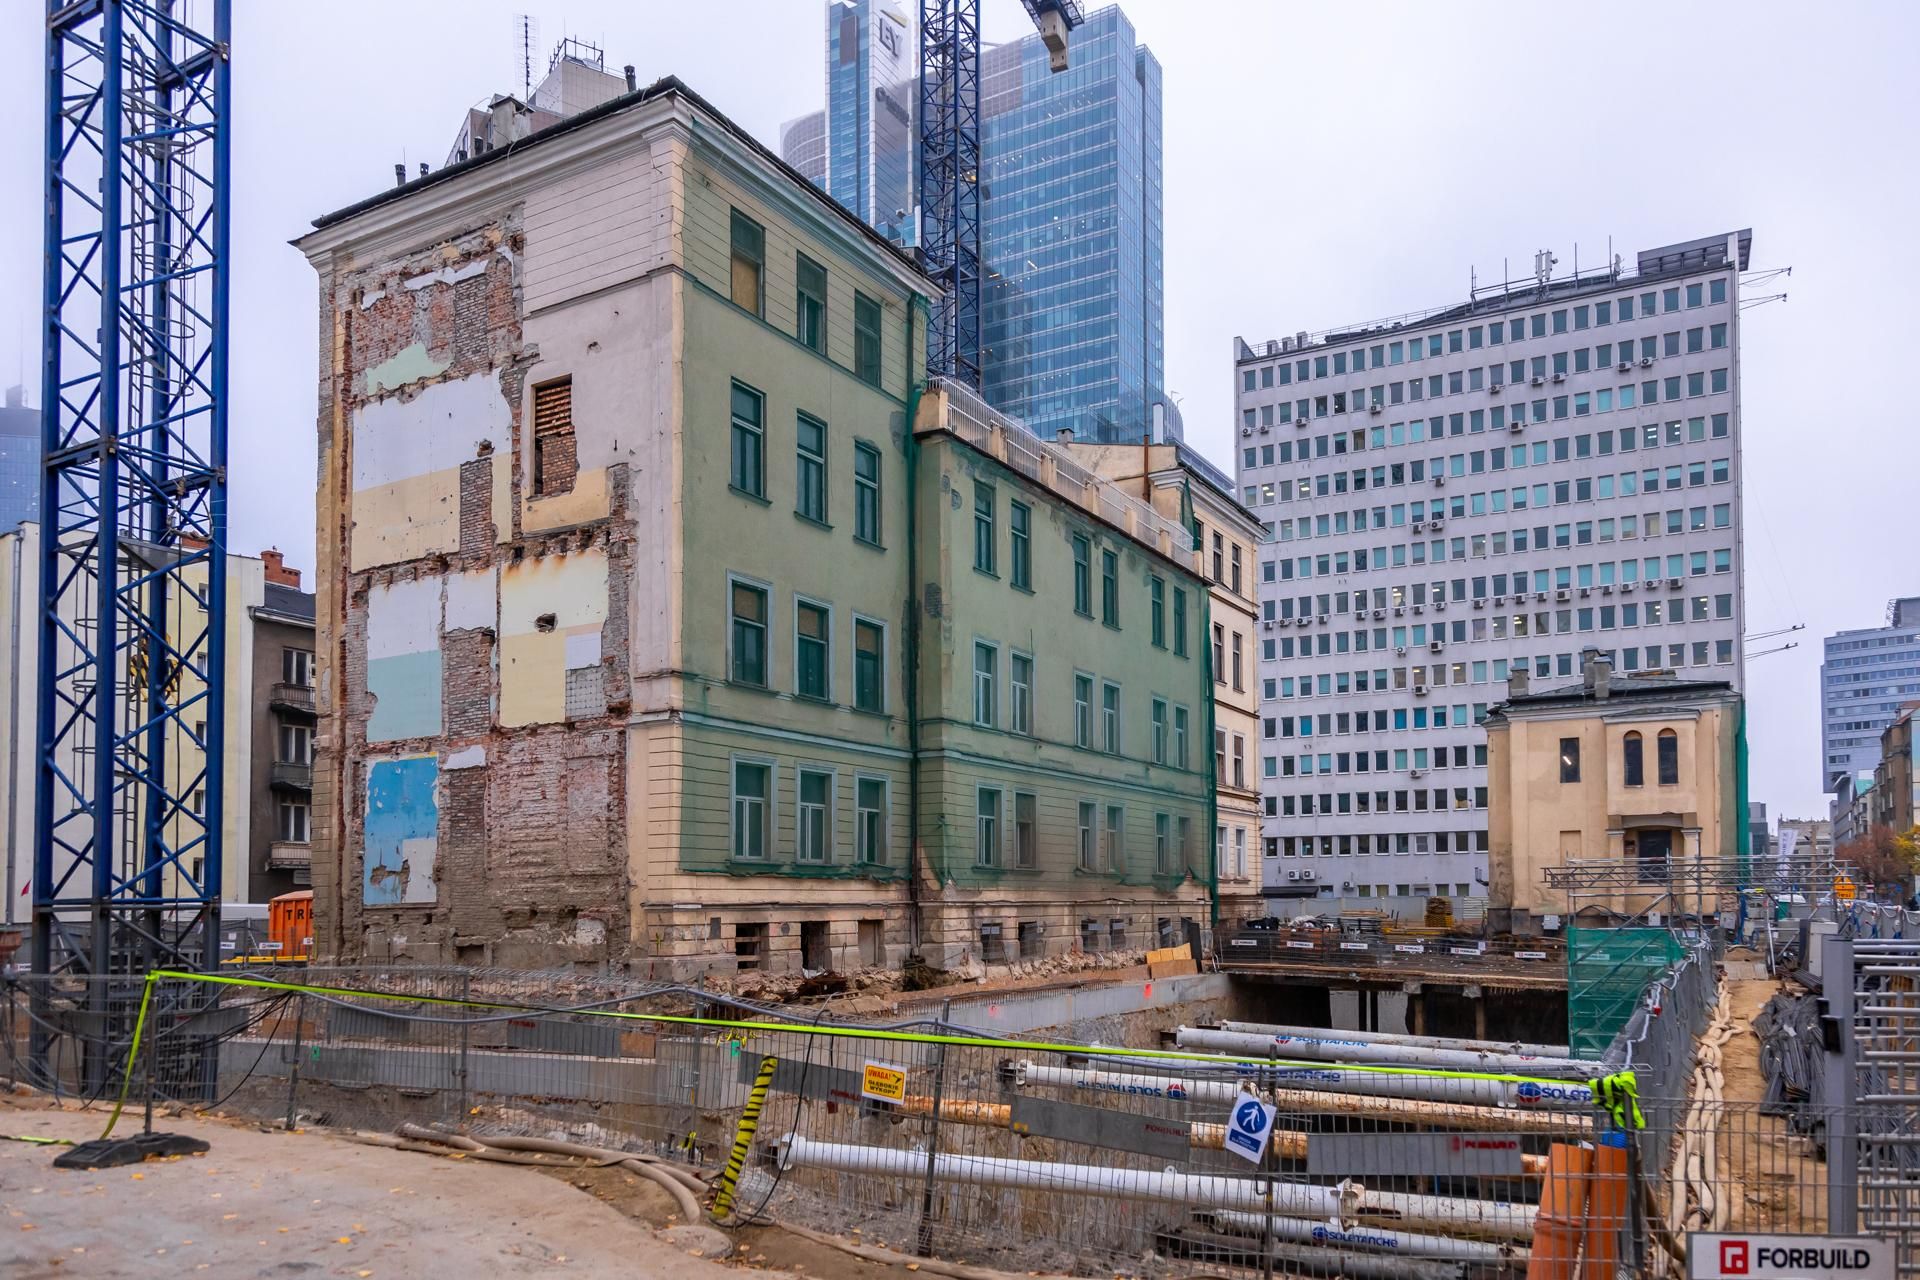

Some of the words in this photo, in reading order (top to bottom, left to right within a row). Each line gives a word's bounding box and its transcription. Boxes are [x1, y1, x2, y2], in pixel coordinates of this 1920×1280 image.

[879, 17, 899, 58] EY
[868, 1069, 891, 1080] UWAGA!
[1328, 1231, 1399, 1248] SOLETANCHE
[1757, 1247, 1870, 1270] FORBUILD
